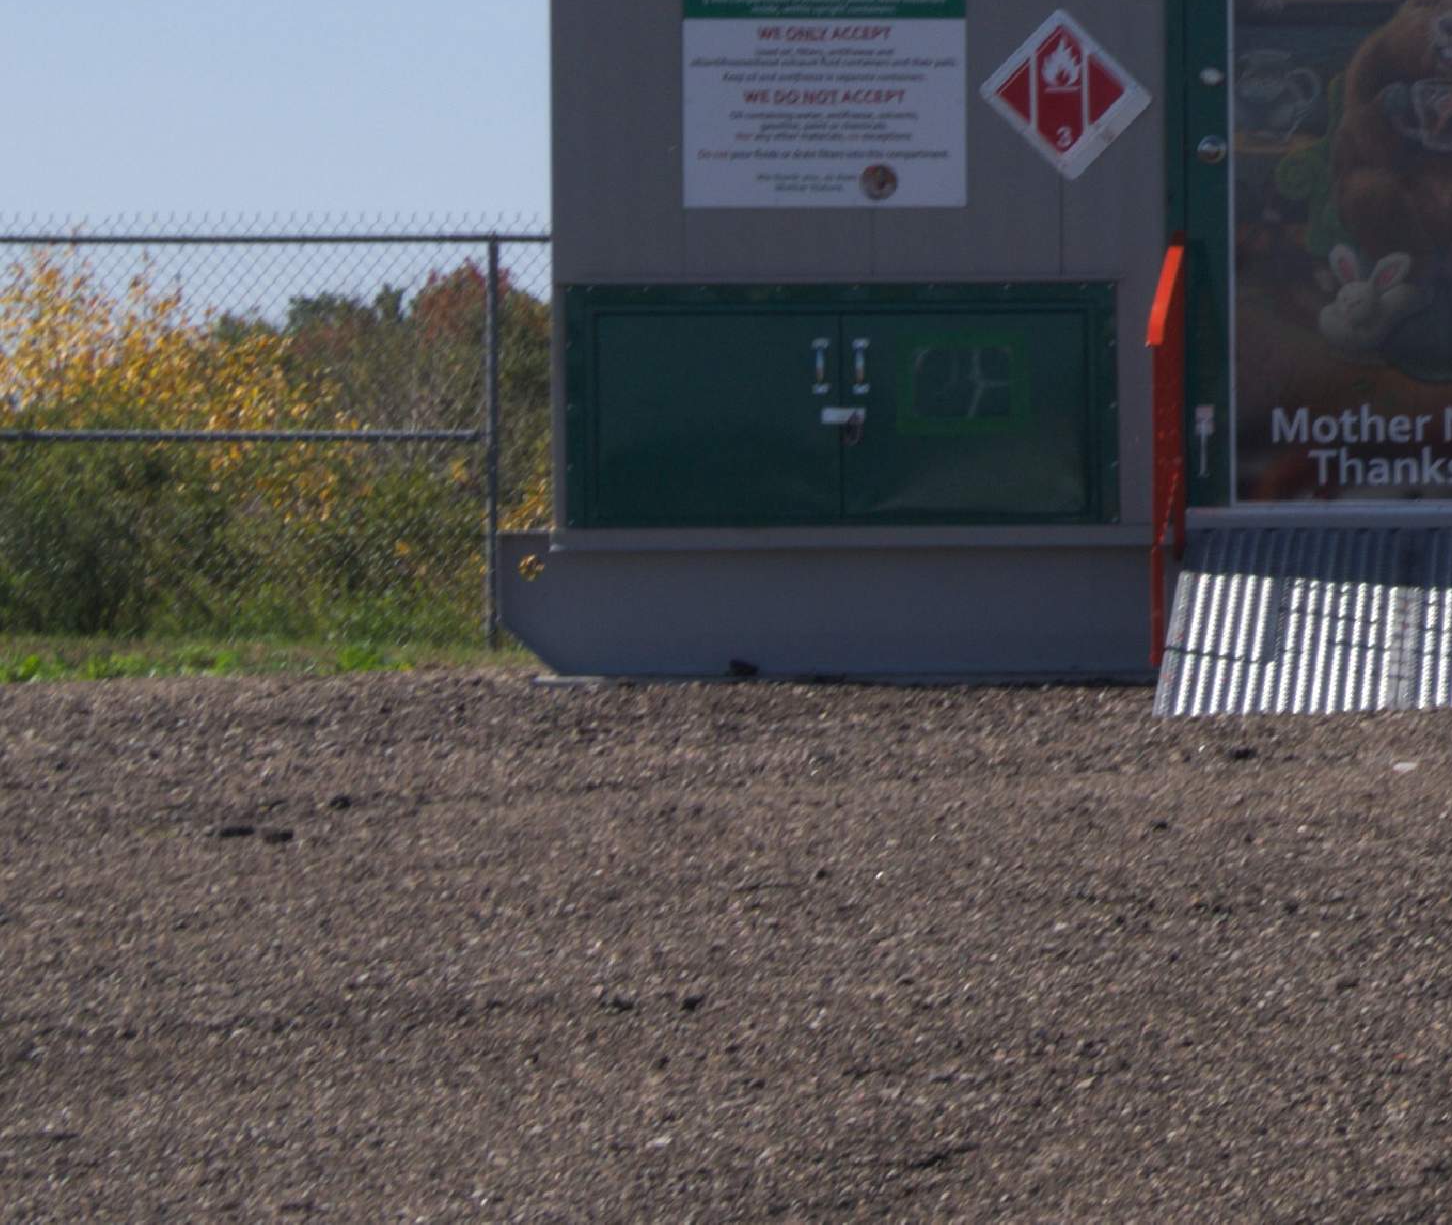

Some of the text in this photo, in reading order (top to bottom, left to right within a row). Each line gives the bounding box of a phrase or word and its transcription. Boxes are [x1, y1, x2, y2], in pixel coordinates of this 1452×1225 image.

[831, 26, 892, 40] ACCEPT
[743, 90, 769, 103] WE
[803, 90, 838, 104] NOT
[841, 90, 905, 104] ACCEPT
[1055, 127, 1073, 147] 3
[1273, 404, 1431, 442] Mother
